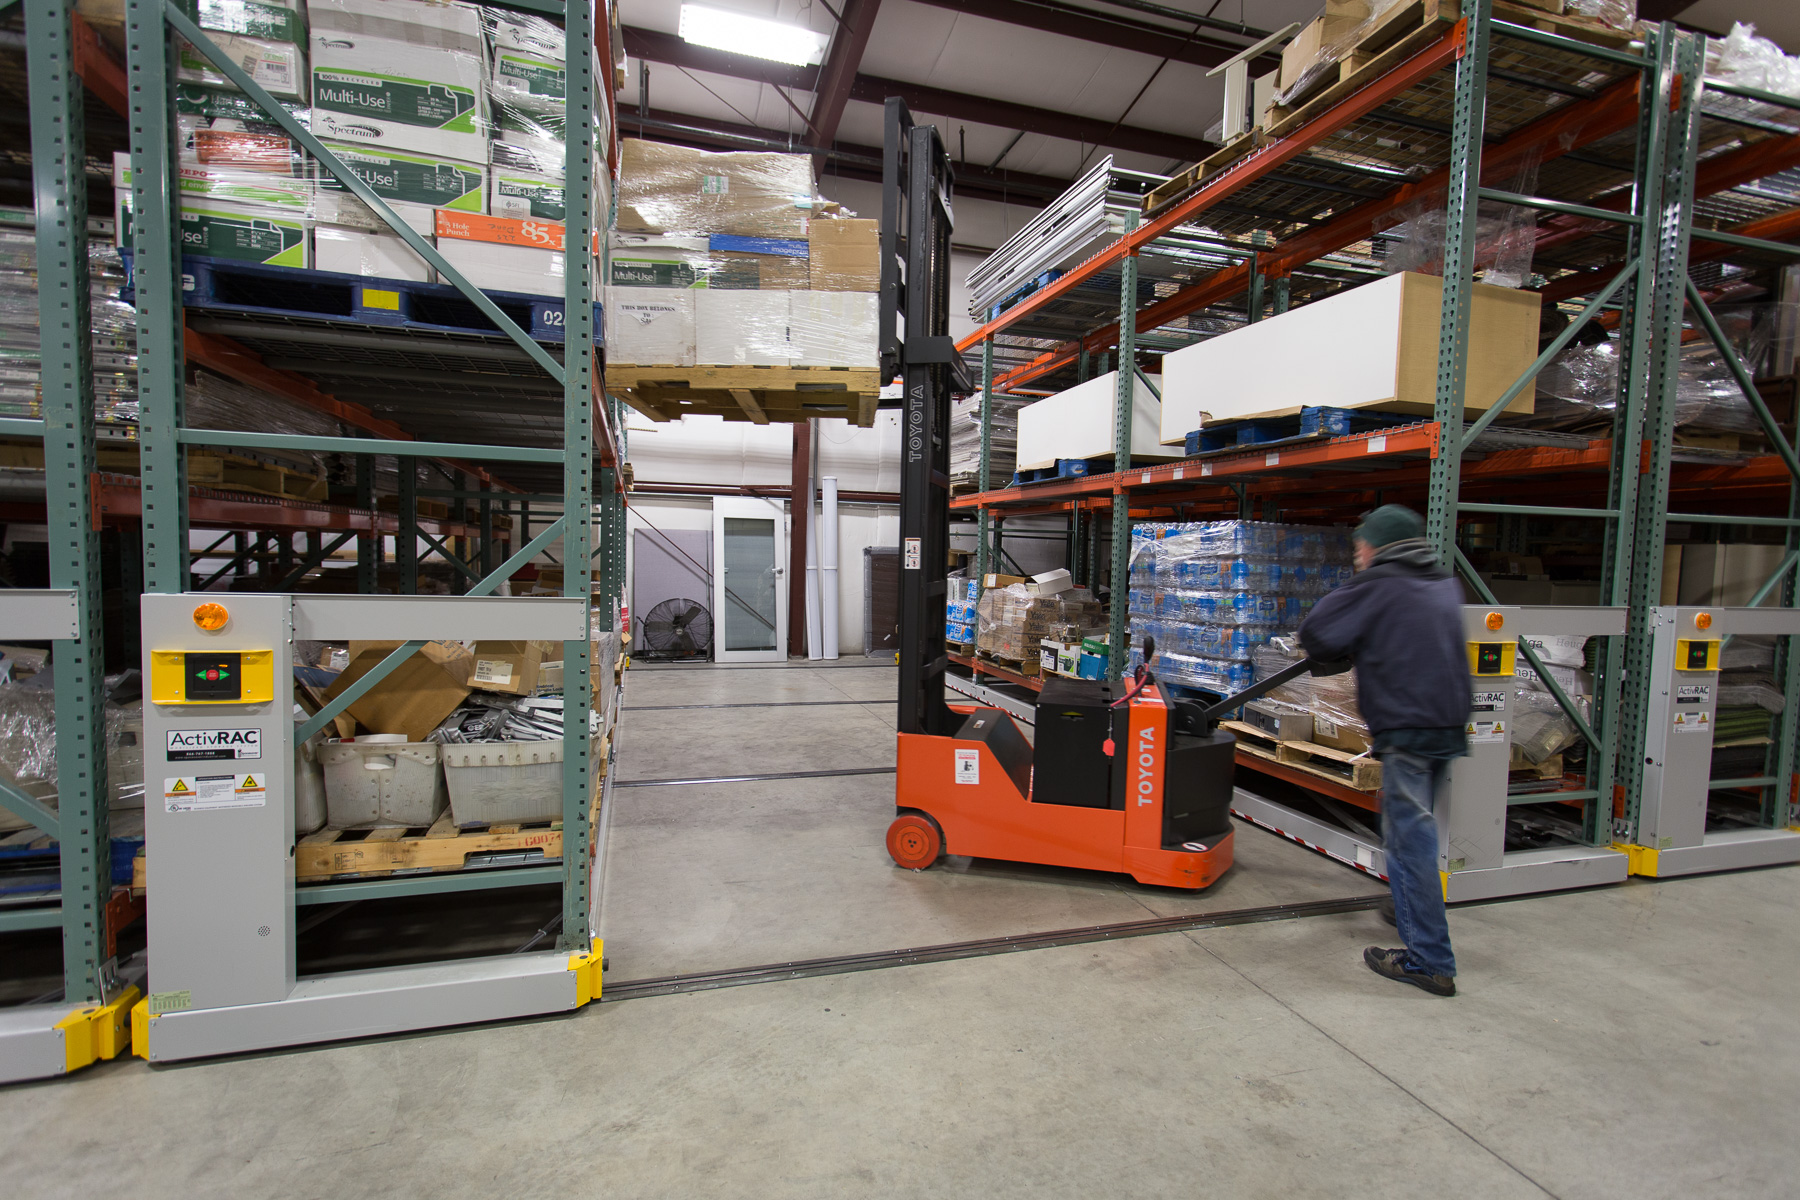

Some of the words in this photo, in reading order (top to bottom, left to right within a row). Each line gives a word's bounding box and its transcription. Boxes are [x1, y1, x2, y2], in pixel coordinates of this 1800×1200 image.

[502, 65, 538, 79] Multi-Use
[341, 76, 380, 86] RECYCLED
[320, 88, 386, 109] Multi-Use
[328, 123, 379, 139] Spectrum
[446, 228, 470, 236] Punch
[453, 222, 470, 230] Hole
[614, 270, 654, 282] Multi-Use
[543, 310, 566, 326] 02
[909, 385, 924, 463] TOYOTA
[1679, 686, 1709, 695] ActivRAC
[170, 730, 258, 746] ActivRAC
[1137, 727, 1155, 807] TOYOTA
